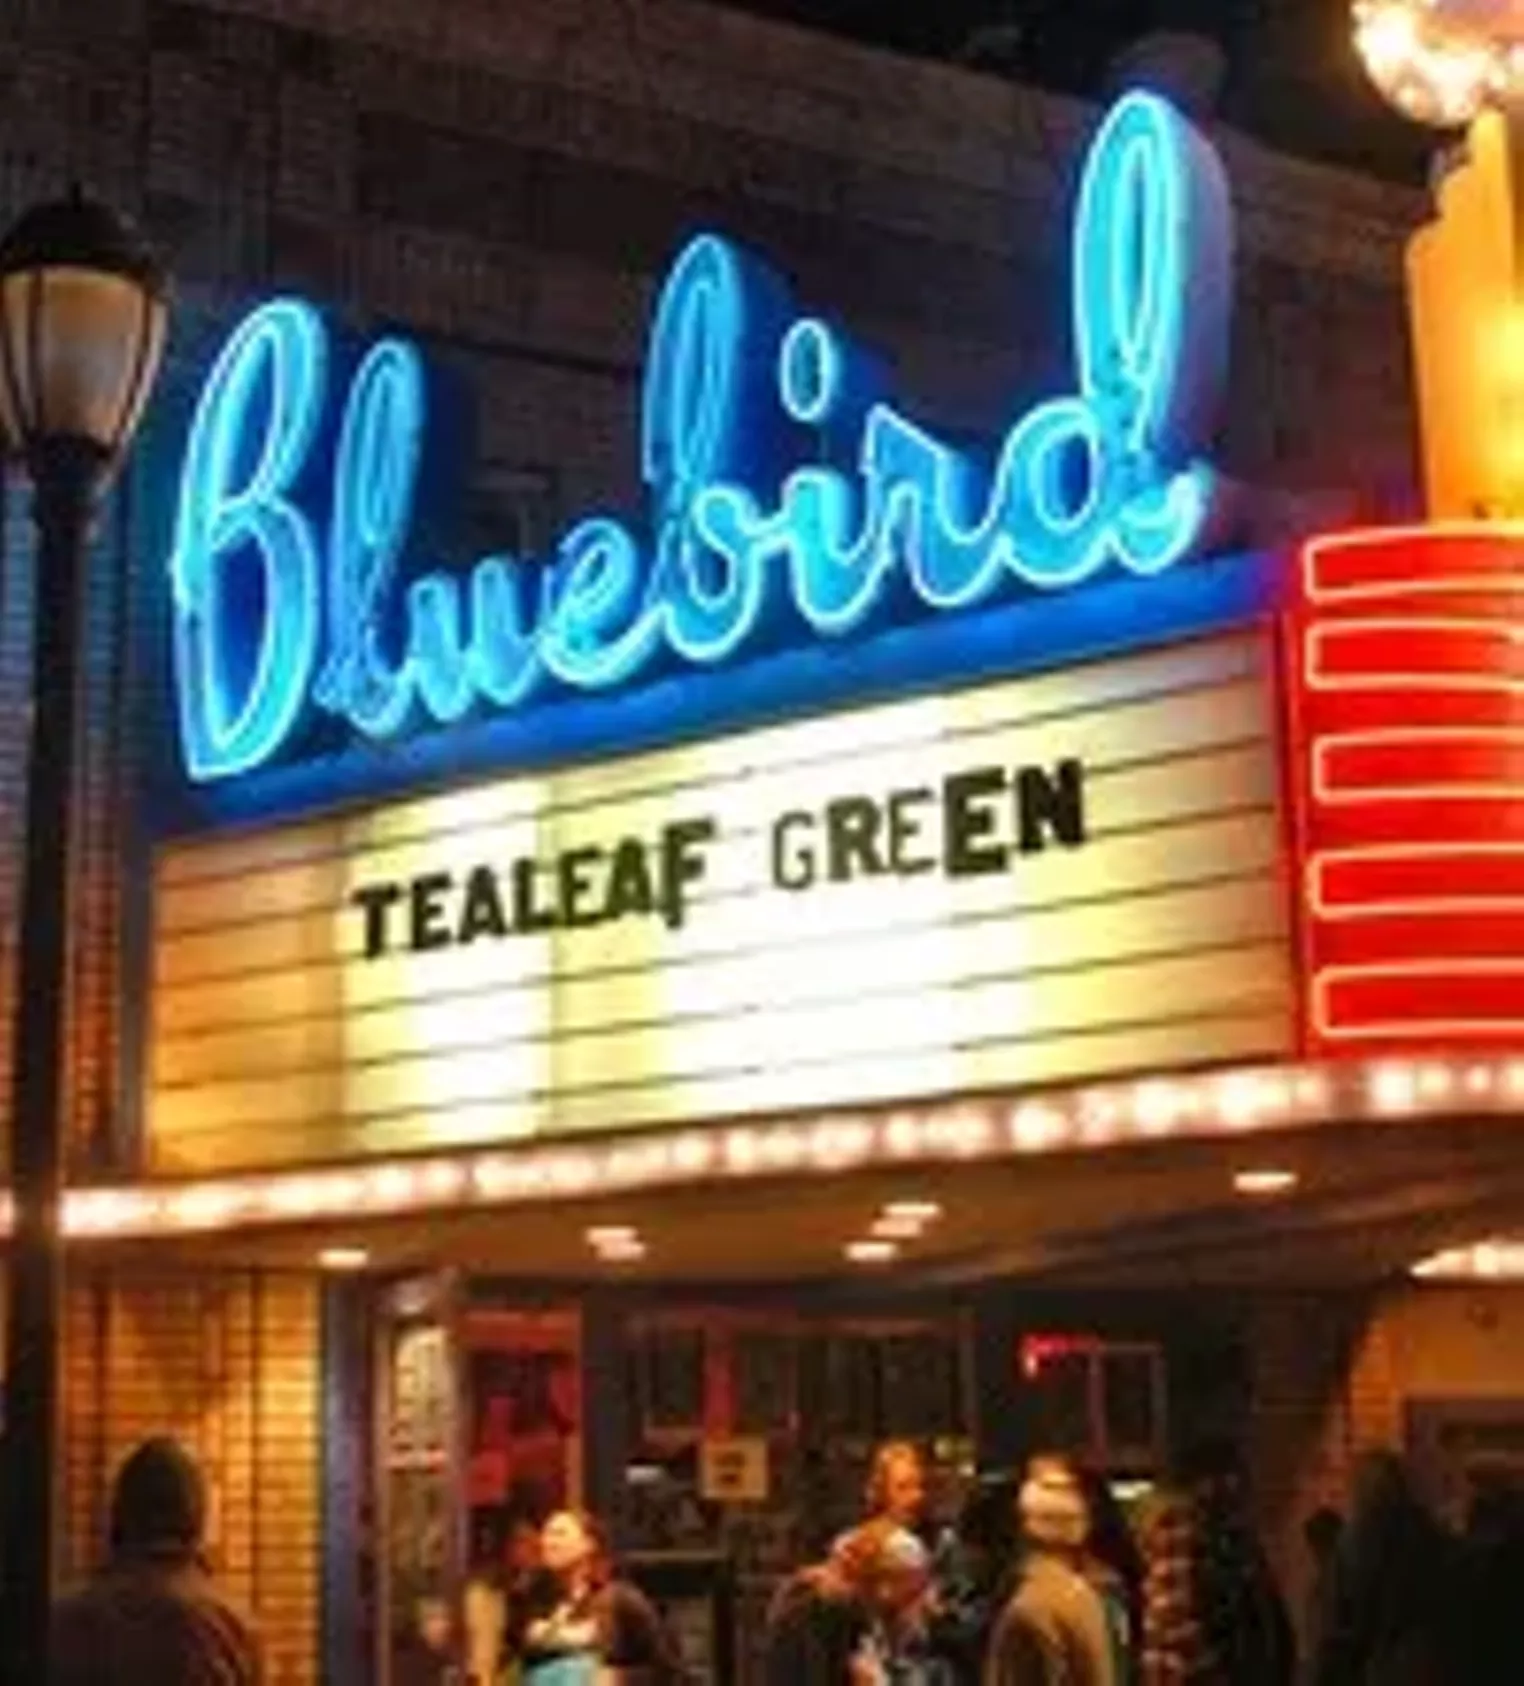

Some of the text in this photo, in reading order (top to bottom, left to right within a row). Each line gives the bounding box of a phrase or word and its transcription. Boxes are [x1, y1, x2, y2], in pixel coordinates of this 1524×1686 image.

[171, 88, 1214, 780] Bluebird
[352, 757, 1087, 960] TEALEAF GREEN
